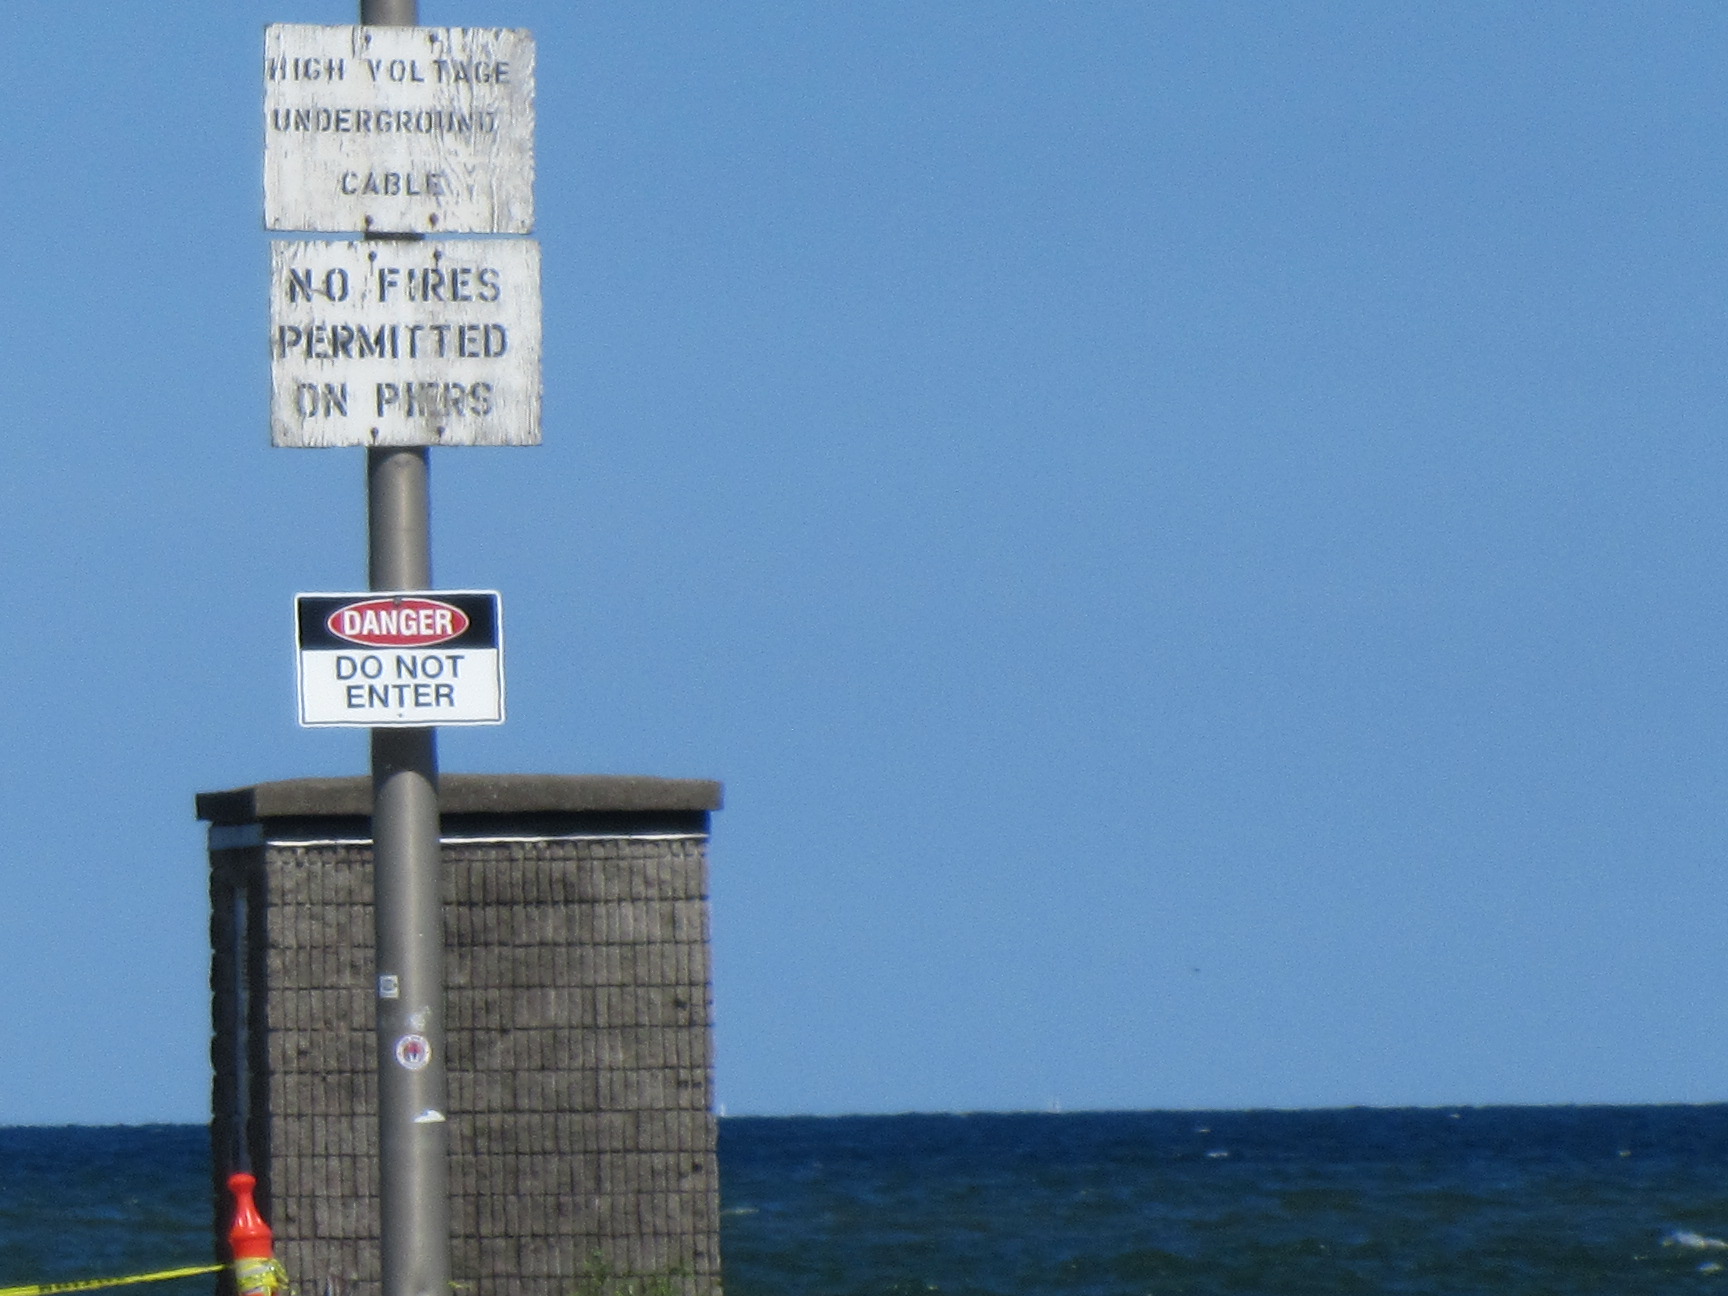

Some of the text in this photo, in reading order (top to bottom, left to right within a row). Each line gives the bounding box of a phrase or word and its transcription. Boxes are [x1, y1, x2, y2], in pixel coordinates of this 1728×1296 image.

[267, 57, 511, 85] HIGH VOLTAGE
[273, 108, 496, 134] UNDERGROUND
[341, 170, 445, 197] CABLE
[289, 267, 501, 303] NO FIRES
[278, 323, 509, 359] PERMITTED
[297, 381, 348, 418] ON
[344, 608, 454, 637] DANGER
[335, 654, 465, 681] DO NOT
[346, 682, 455, 709] ENTER
